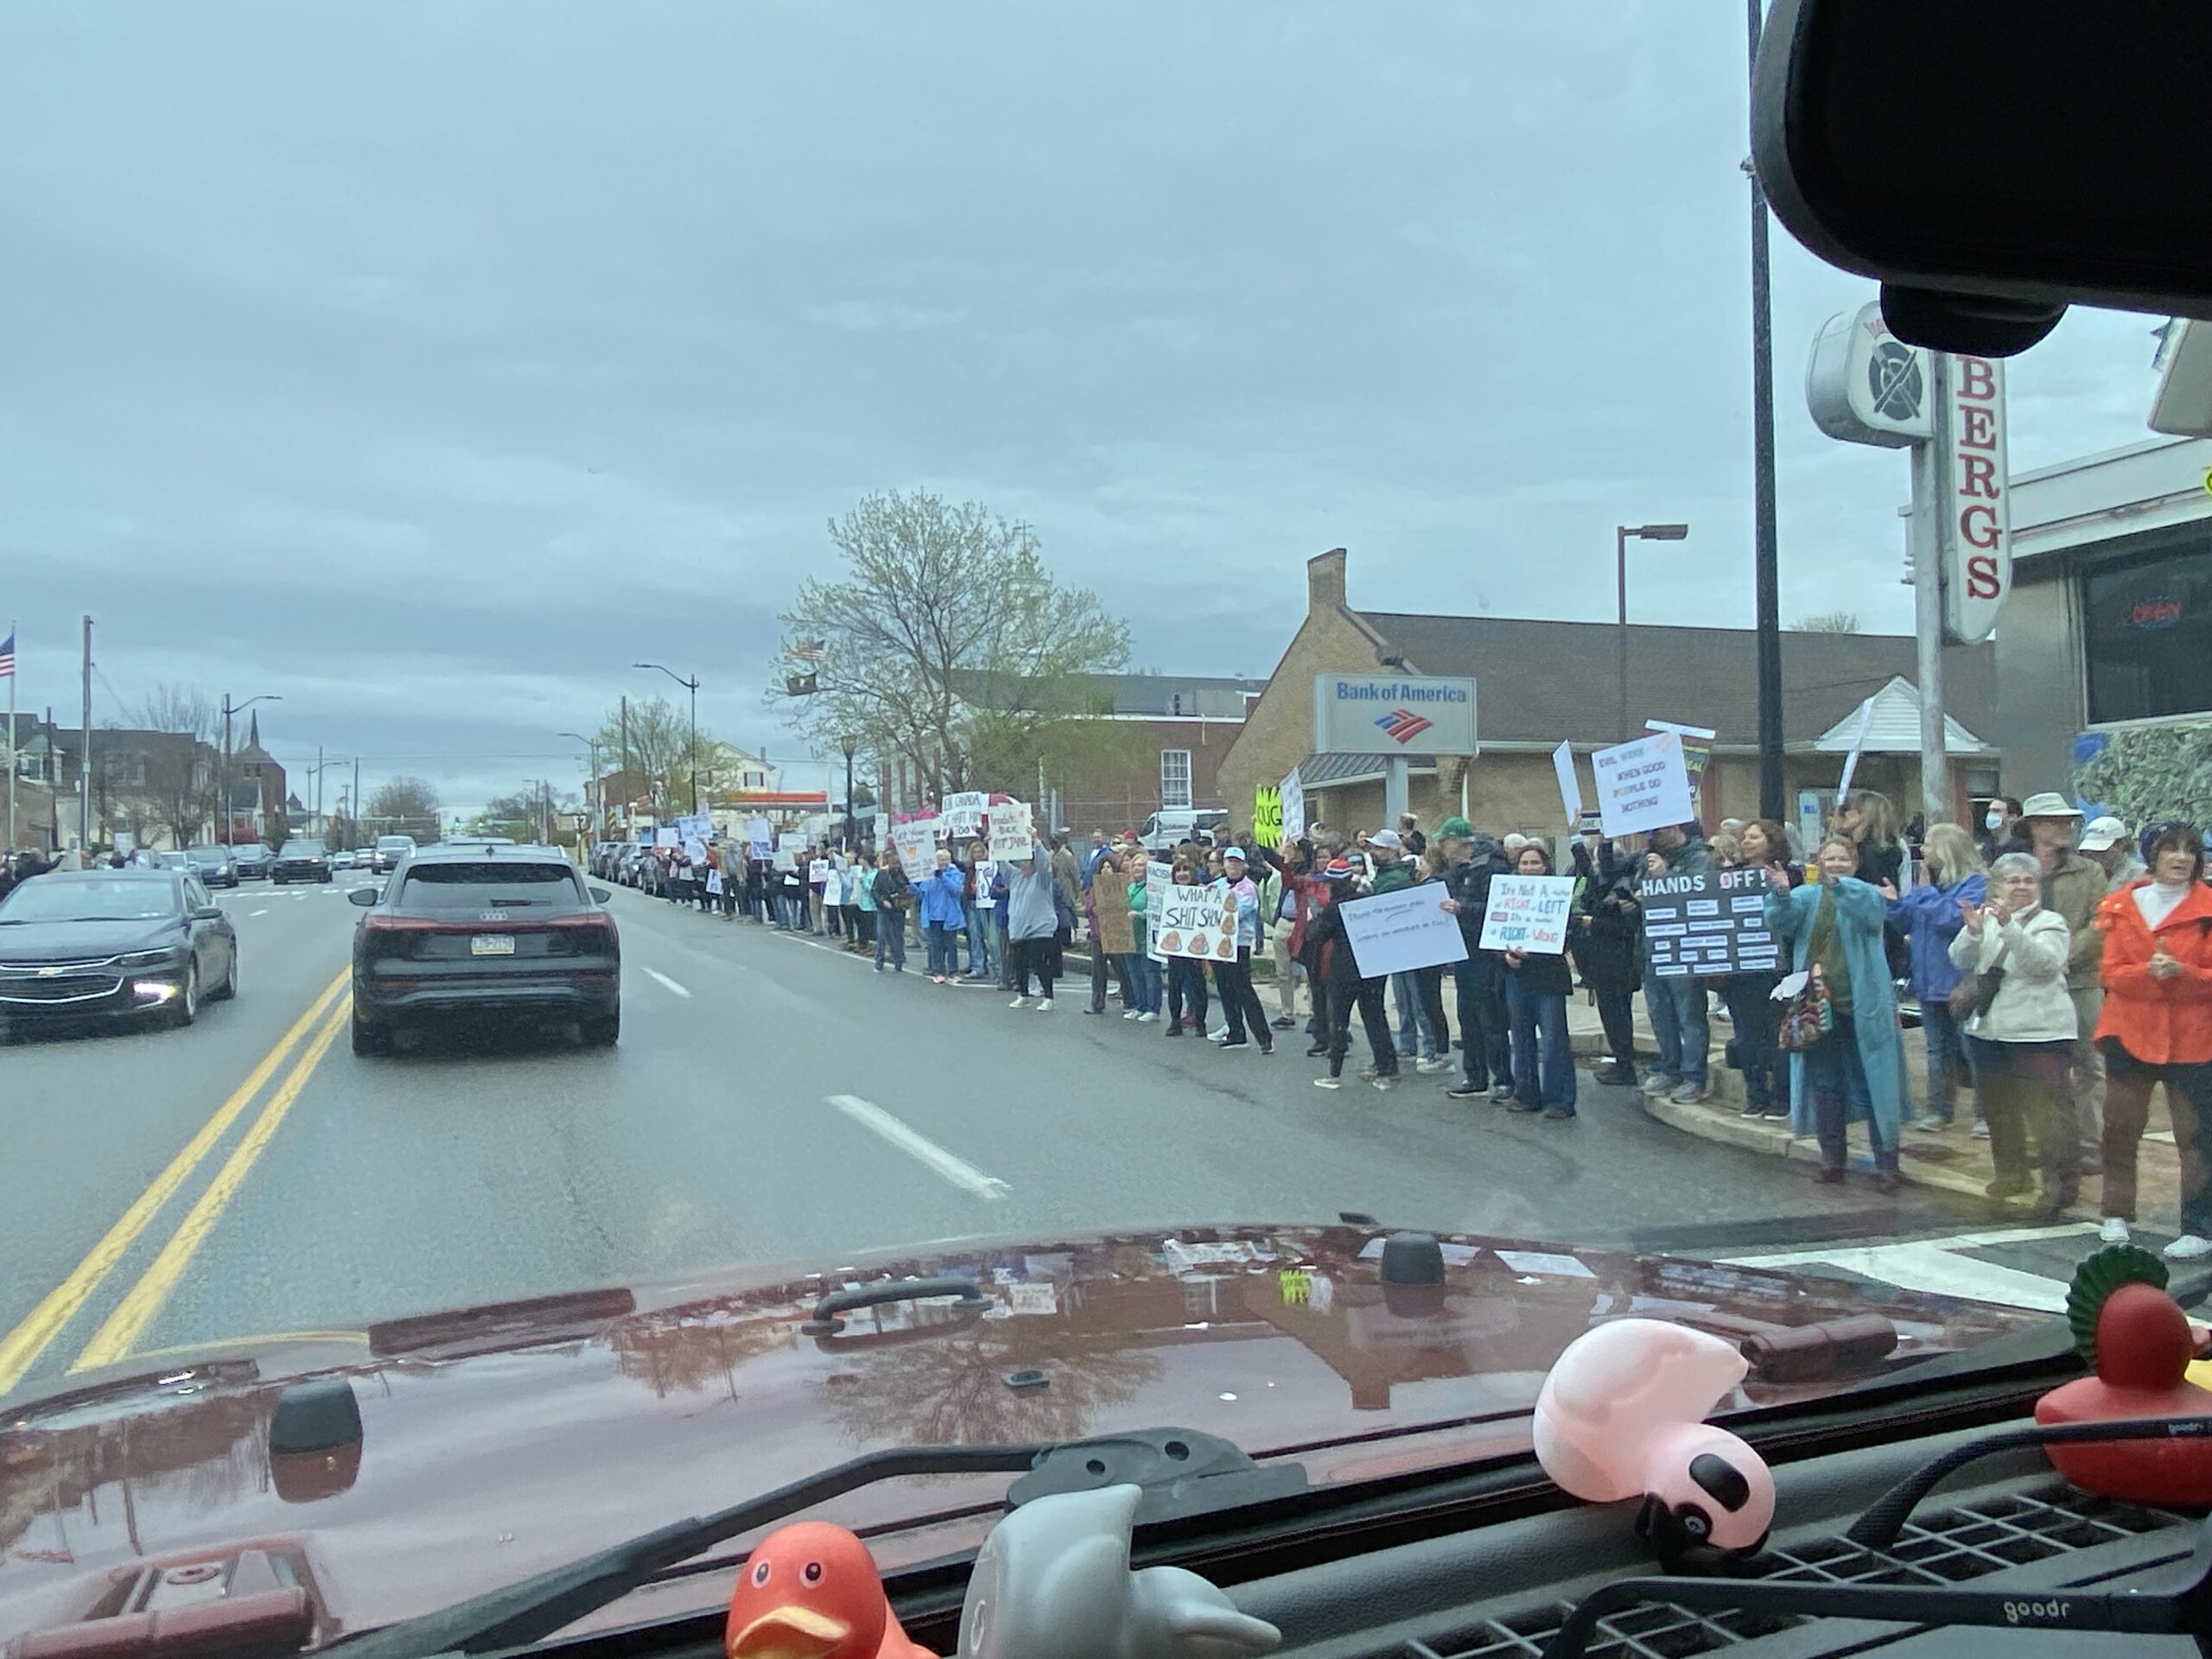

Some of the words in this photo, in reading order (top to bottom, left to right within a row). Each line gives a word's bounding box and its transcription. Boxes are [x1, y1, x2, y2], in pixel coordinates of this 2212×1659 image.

[1955, 355, 2002, 600] BERGS
[1337, 682, 1379, 700] Bank
[1382, 683, 1398, 701] of
[1400, 684, 1467, 702] America
[1618, 767, 1641, 781] WHEN
[1642, 760, 1666, 775] GOOD
[1612, 781, 1646, 799] PEOPLE
[1648, 778, 1662, 790] DO
[1621, 796, 1659, 814] NOTHING
[1177, 887, 1207, 902] WHAT
[1213, 889, 1222, 904] A
[1642, 874, 1706, 896] HANDS
[1538, 899, 1566, 914] LEFT
[2003, 1599, 2070, 1624] goodr
